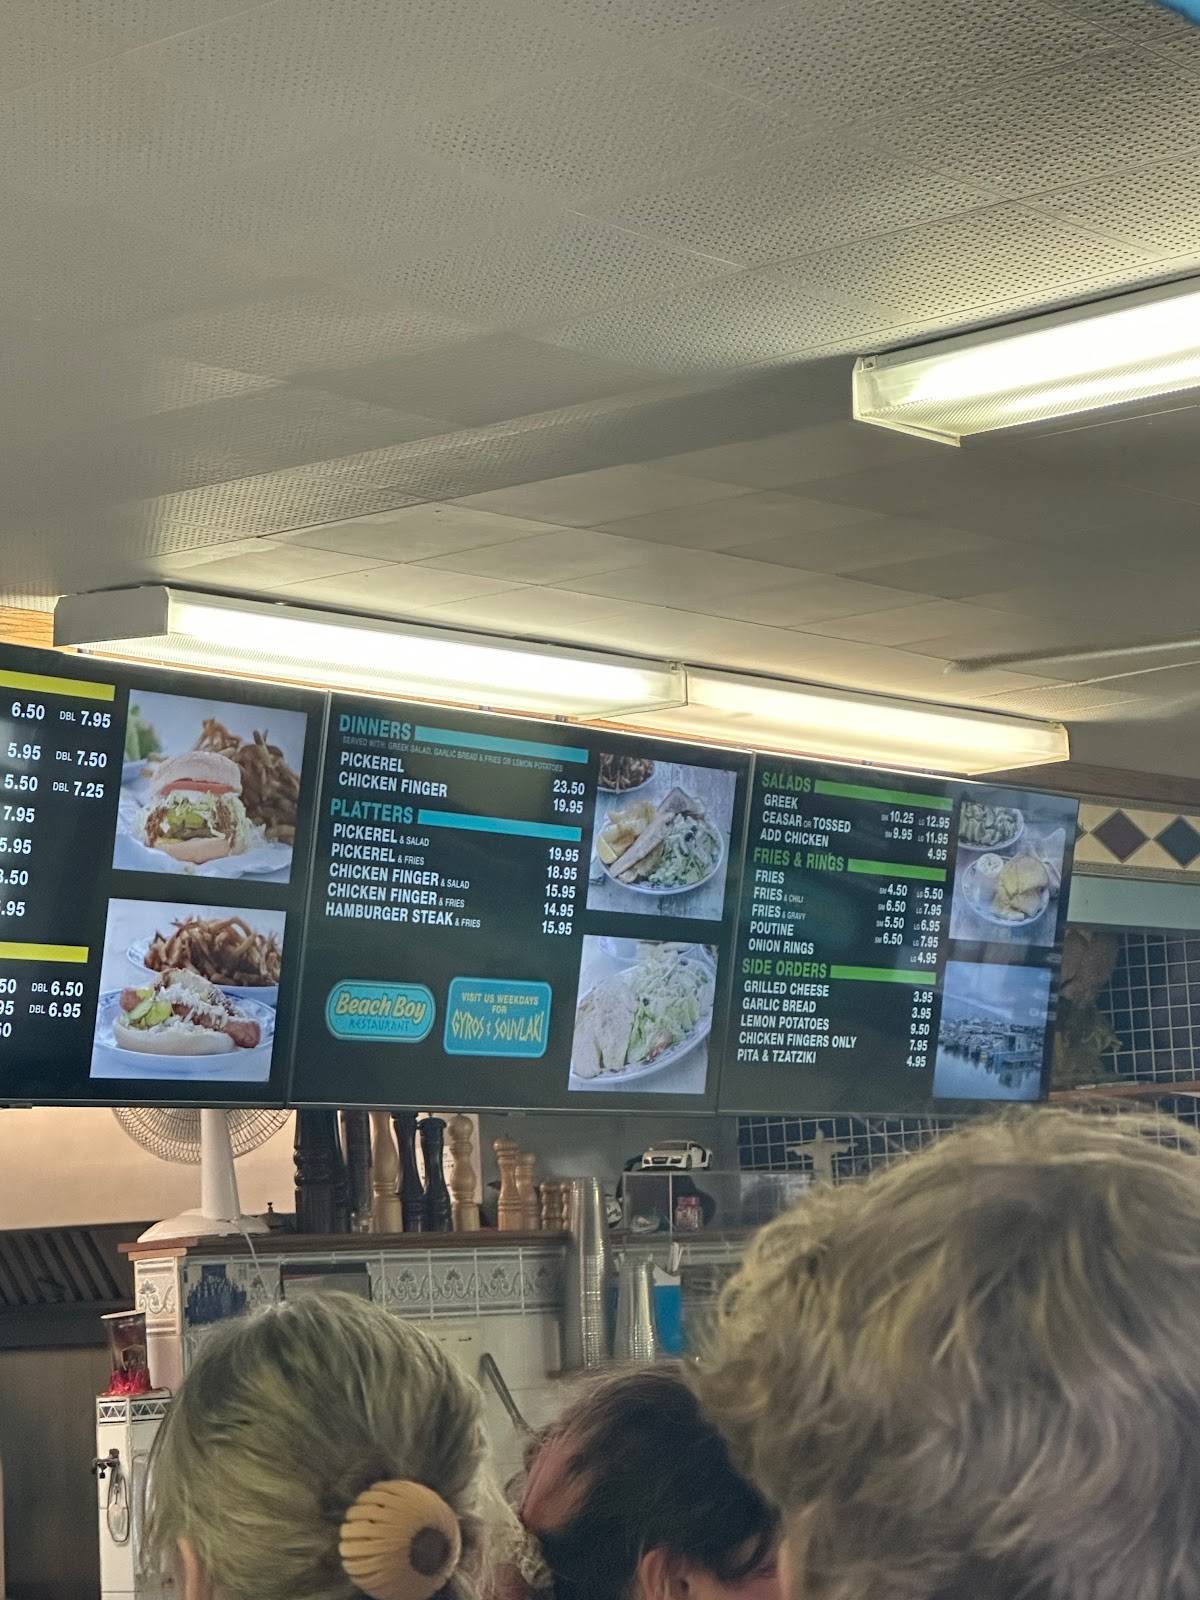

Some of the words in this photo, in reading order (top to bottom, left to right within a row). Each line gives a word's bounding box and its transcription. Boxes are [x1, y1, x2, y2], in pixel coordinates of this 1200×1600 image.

[11, 701, 45, 720] 6.50
[59, 710, 76, 721] DBL
[80, 710, 112, 729] 7.95
[339, 714, 412, 740] DINNERS
[7, 742, 42, 760] 5.95
[55, 750, 73, 761] DBL
[76, 750, 107, 768] 7.50
[340, 751, 404, 773] PICKEREL
[4, 773, 38, 792] 5.50
[52, 781, 69, 793] DBL
[73, 781, 104, 799] 7.25
[339, 771, 397, 792] CHICKEN
[401, 779, 448, 798] FINGER
[553, 779, 585, 796] 23.50
[762, 772, 811, 793] SALADS
[553, 798, 584, 814] 19.95
[764, 793, 799, 810] GREEK
[3, 805, 35, 823] 7.95
[330, 797, 413, 824] PLATTERS
[762, 810, 802, 827] CEASAR
[813, 816, 851, 833] TOSSED
[890, 810, 914, 824] 10.25
[926, 815, 950, 829] 12.95
[333, 823, 398, 843] PICKEREL
[399, 836, 404, 844] &
[406, 836, 430, 847] SALAD
[760, 827, 782, 842] ADD
[784, 830, 829, 848] CHICKEN
[893, 827, 913, 841] 9.95
[925, 831, 949, 845] 11.95
[331, 842, 396, 863] PICKEREL
[397, 855, 403, 864] &
[404, 855, 425, 866] FRIES
[549, 846, 579, 862] 19.95
[753, 847, 790, 867] FRIES
[793, 852, 801, 868] &
[806, 852, 845, 872] RINGS
[927, 847, 947, 861] 4.95
[329, 862, 388, 882] CHICKEN
[392, 868, 439, 887] FINGER
[440, 878, 445, 887] &
[446, 878, 470, 890] SALAD
[546, 865, 577, 880] 18.95
[755, 869, 785, 884] FRIES
[327, 882, 387, 901] CHICKEN
[390, 887, 437, 906] FINGER
[438, 898, 444, 906] &
[445, 898, 465, 909] FRIES
[545, 883, 576, 899] 15.95
[753, 886, 783, 902] FRIES
[887, 883, 908, 896] 4.50
[924, 887, 944, 900] 5.50
[0, 900, 25, 917] .95
[325, 901, 409, 923] HAMBURGER
[412, 909, 454, 926] STEAK
[455, 919, 460, 927] &
[461, 918, 481, 929] FRIES
[543, 902, 574, 917] 14.95
[751, 903, 781, 919] FRIES
[886, 900, 906, 913] 6.50
[923, 903, 942, 916] 7.95
[542, 920, 573, 936] 15.95
[750, 920, 794, 937] POUTINE
[884, 916, 904, 930] 5.50
[921, 919, 940, 932] 6.95
[748, 938, 780, 953] ONION
[783, 940, 814, 955] RINGS
[883, 932, 903, 946] 6.50
[920, 935, 939, 949] 7.95
[917, 951, 937, 965] 4.95
[742, 958, 772, 976] SIDE
[776, 960, 827, 979] ORDERS
[31, 982, 48, 993] DBL
[50, 980, 84, 997] 6.50
[744, 980, 787, 995] GRILLED
[789, 983, 829, 997] CHEESE
[913, 991, 934, 1003] 3.95
[335, 991, 391, 1016] Beach
[392, 994, 426, 1025] Boy
[497, 994, 540, 1006] WEEKDAYS
[742, 997, 780, 1012] GARLIC
[782, 1000, 817, 1014] BREAD
[28, 1004, 46, 1014] DBL
[48, 1001, 82, 1018] 6.95
[491, 1005, 508, 1015] FOR
[911, 1007, 932, 1020] 3.95
[0, 1022, 12, 1038] 0
[349, 1018, 410, 1033] RESTAURANT
[452, 1008, 485, 1041] GYROS
[493, 1011, 545, 1043] SOUVLAKI
[740, 1014, 776, 1028] LEMON
[778, 1016, 830, 1031] POTATOES
[910, 1023, 930, 1036] 9.50
[739, 1031, 784, 1046] CHICKEN
[786, 1033, 829, 1048] FINGERS
[831, 1036, 857, 1049] ONLY
[909, 1039, 928, 1052] 7.95
[737, 1049, 760, 1062] PITA
[761, 1049, 769, 1062] &
[772, 1050, 817, 1064] TZATZIKI
[906, 1056, 927, 1068] 4.95
